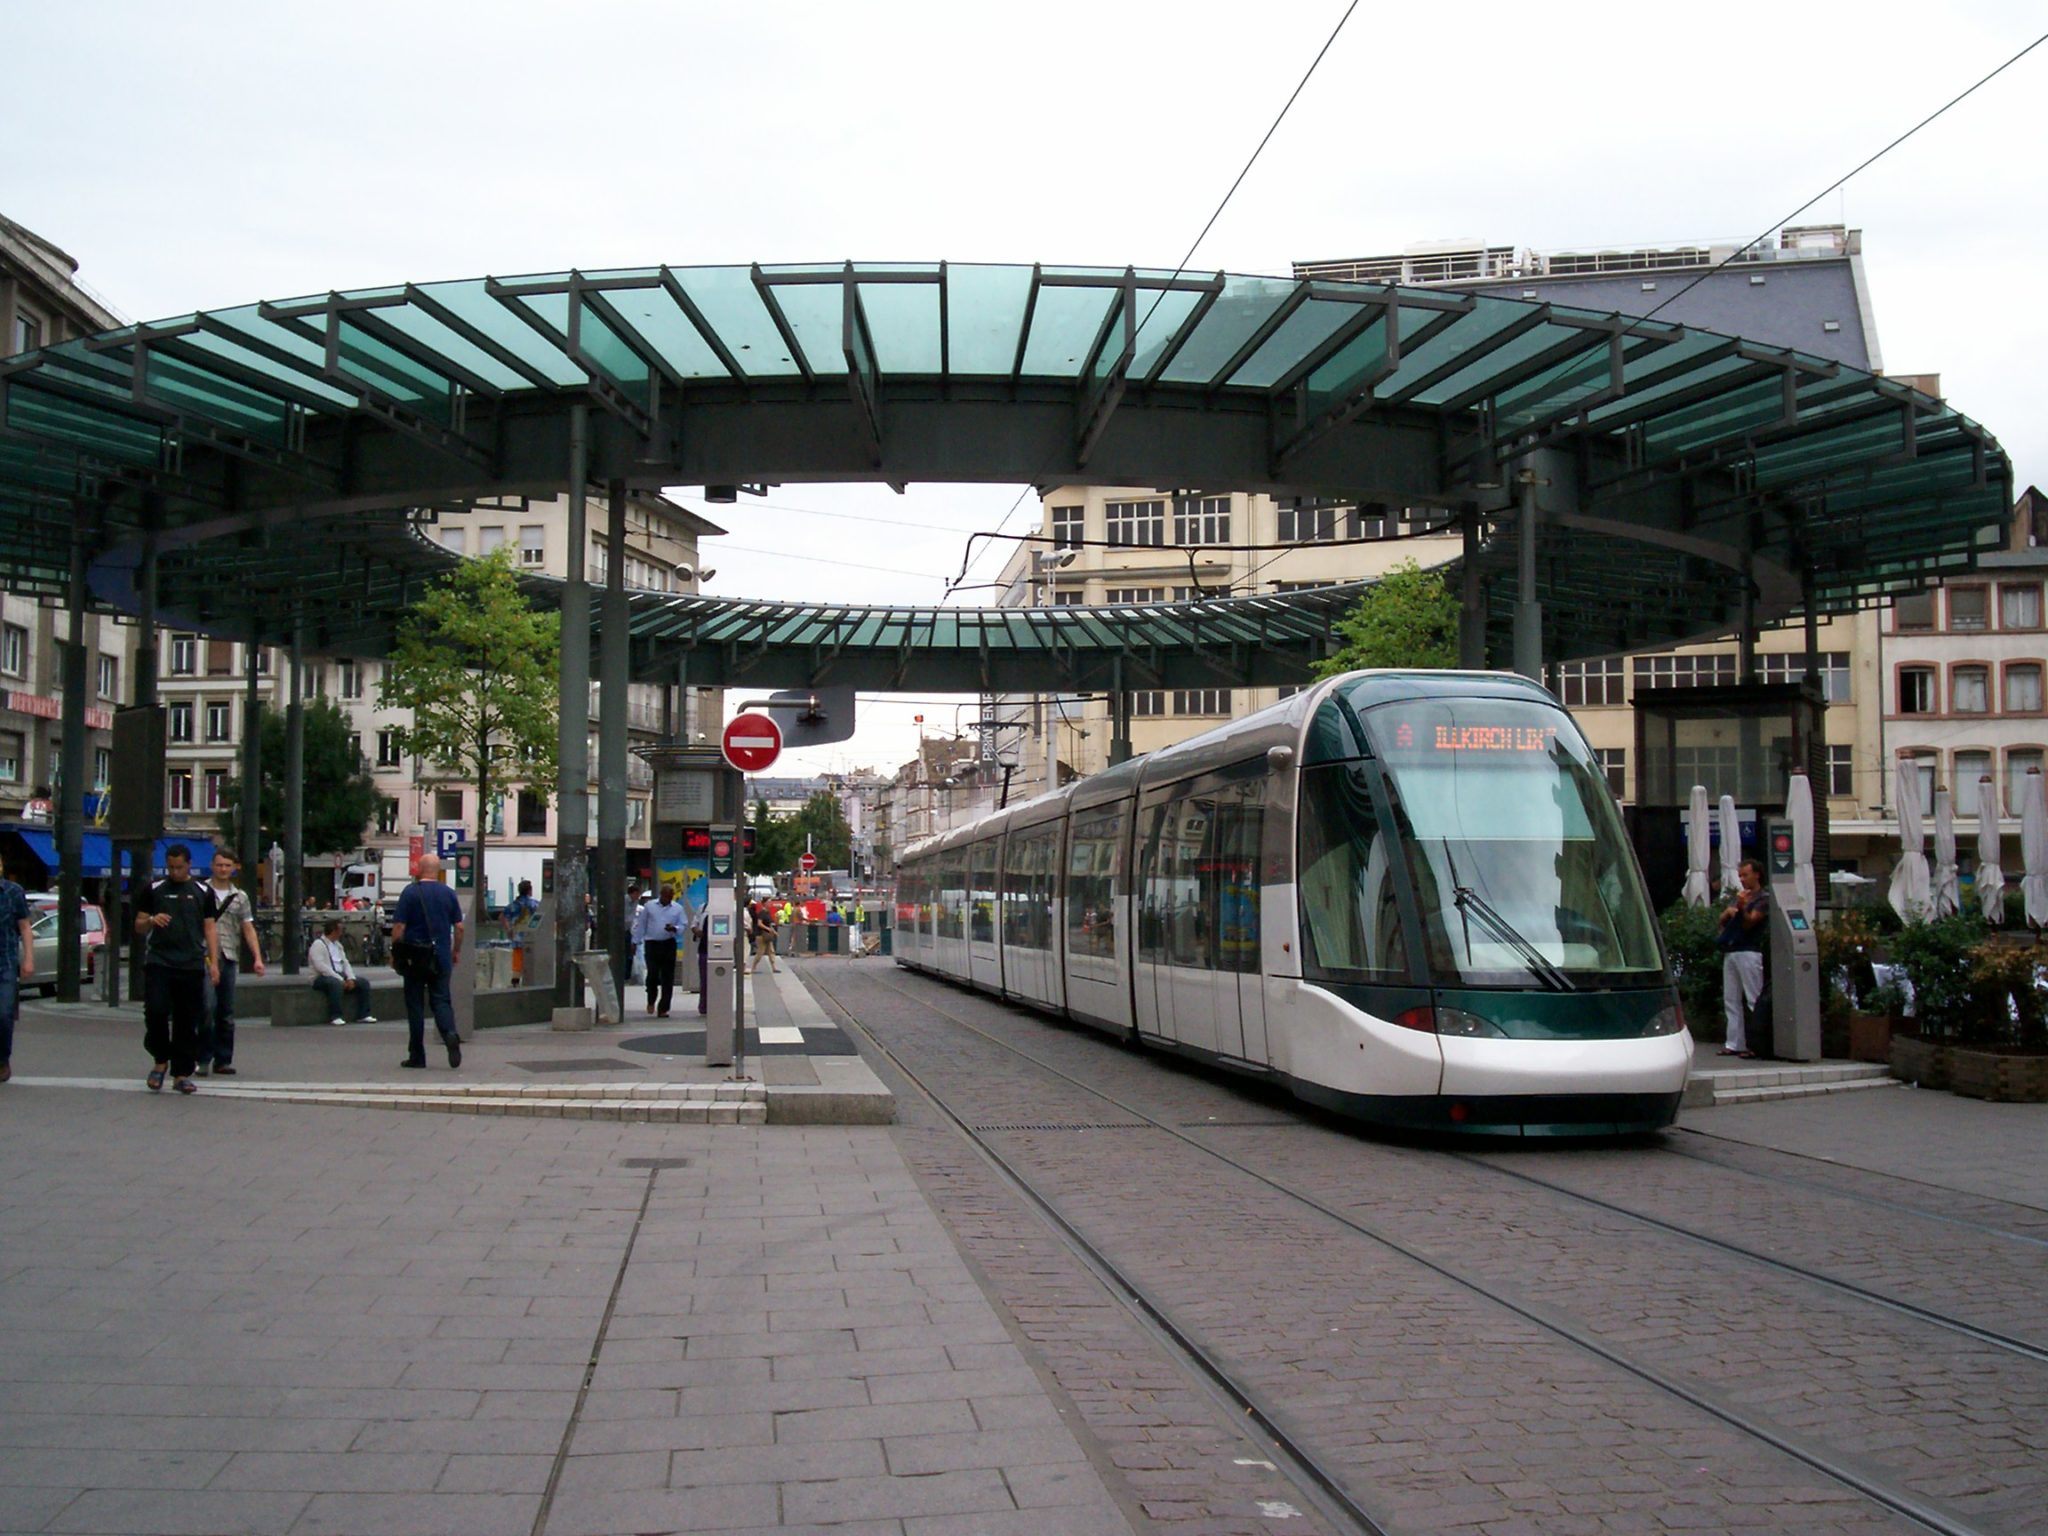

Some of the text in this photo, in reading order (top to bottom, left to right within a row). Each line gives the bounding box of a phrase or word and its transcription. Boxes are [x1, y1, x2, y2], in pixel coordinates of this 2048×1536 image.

[1397, 722, 1412, 747] A
[1435, 726, 1512, 749] ILLKIRCH
[443, 831, 458, 850] P
